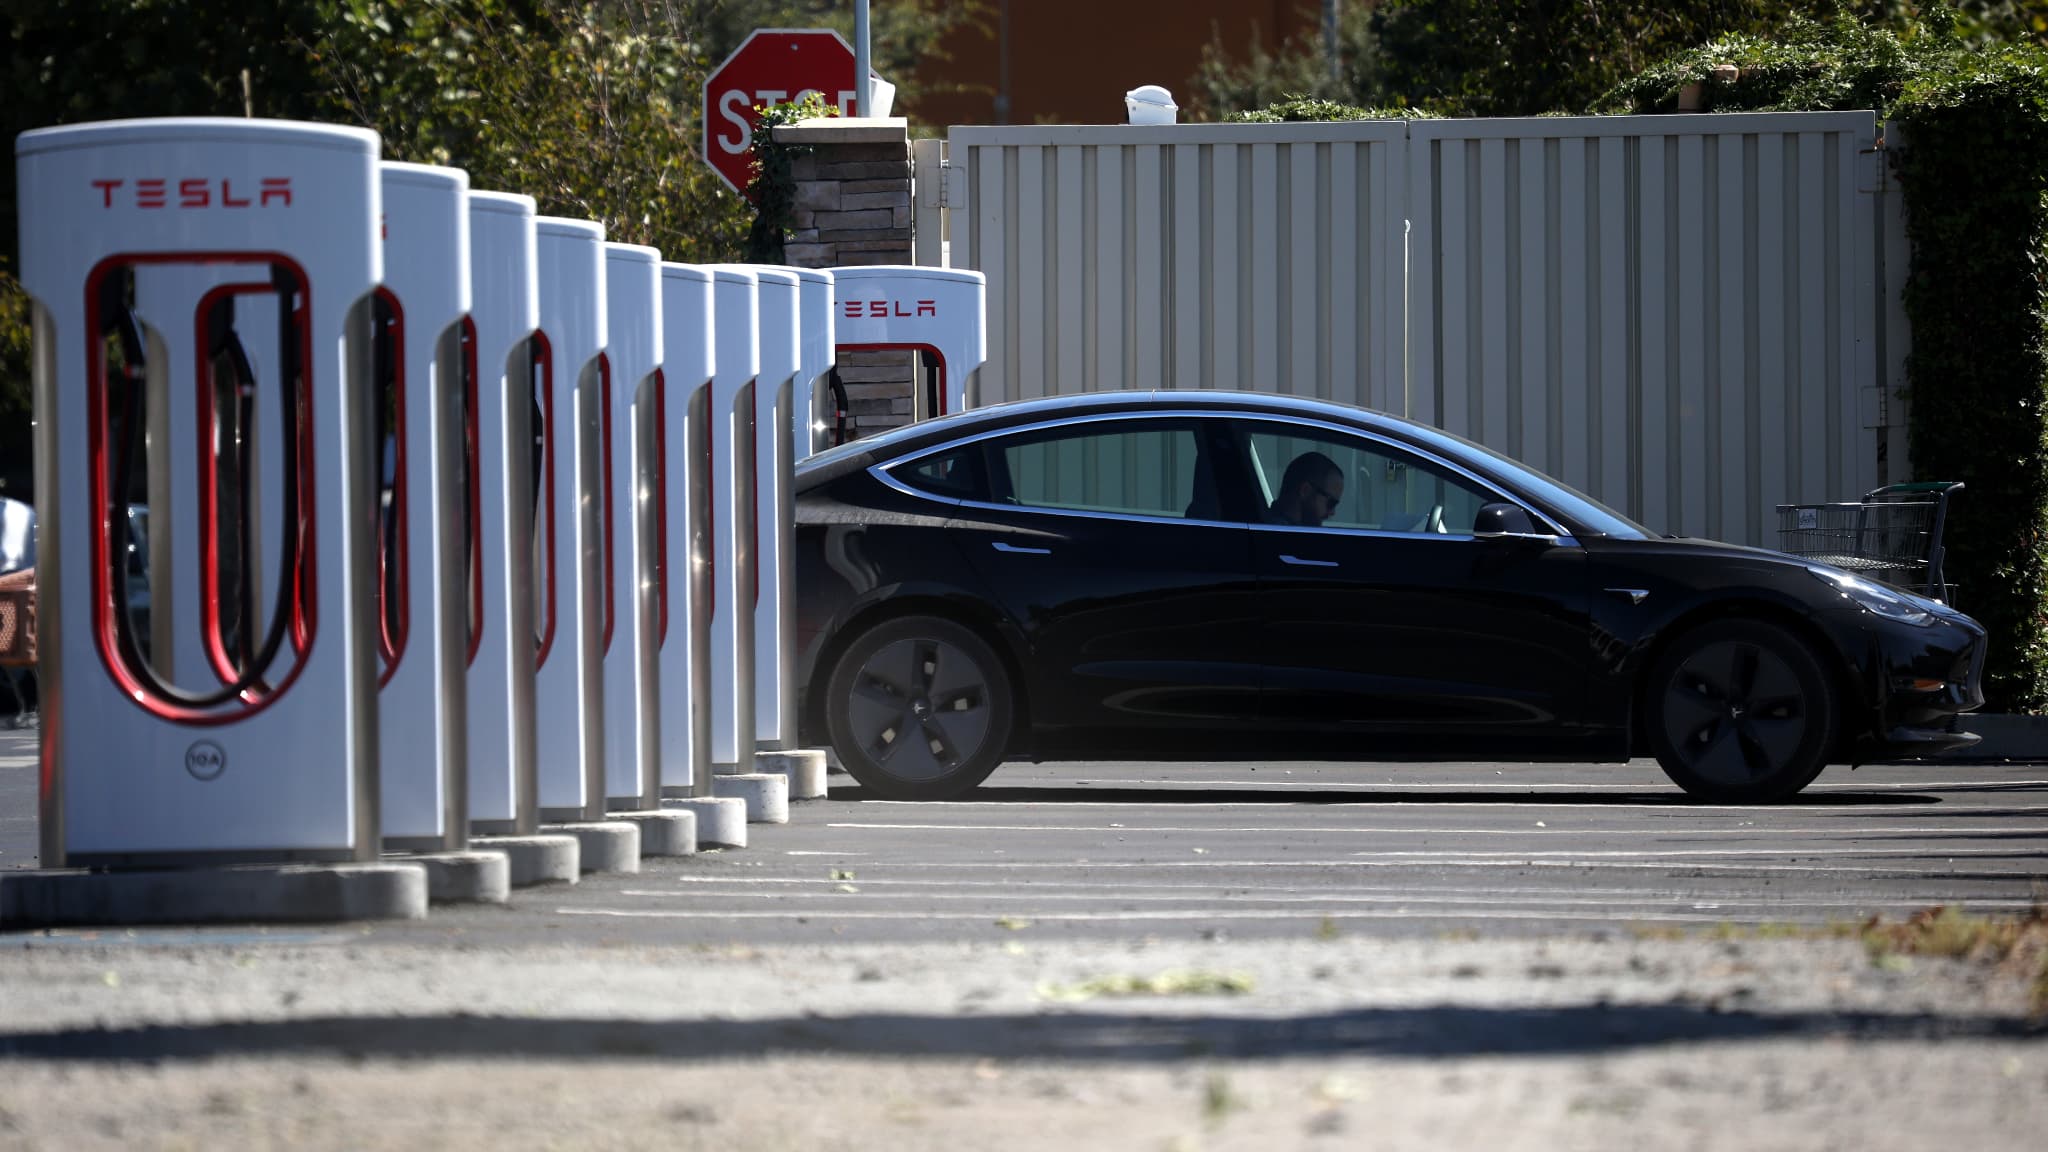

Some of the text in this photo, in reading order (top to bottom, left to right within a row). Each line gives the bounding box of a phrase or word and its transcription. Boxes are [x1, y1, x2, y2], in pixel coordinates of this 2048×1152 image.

[717, 89, 858, 154] ST
[91, 178, 292, 208] TESLA
[834, 300, 936, 318] ESLA
